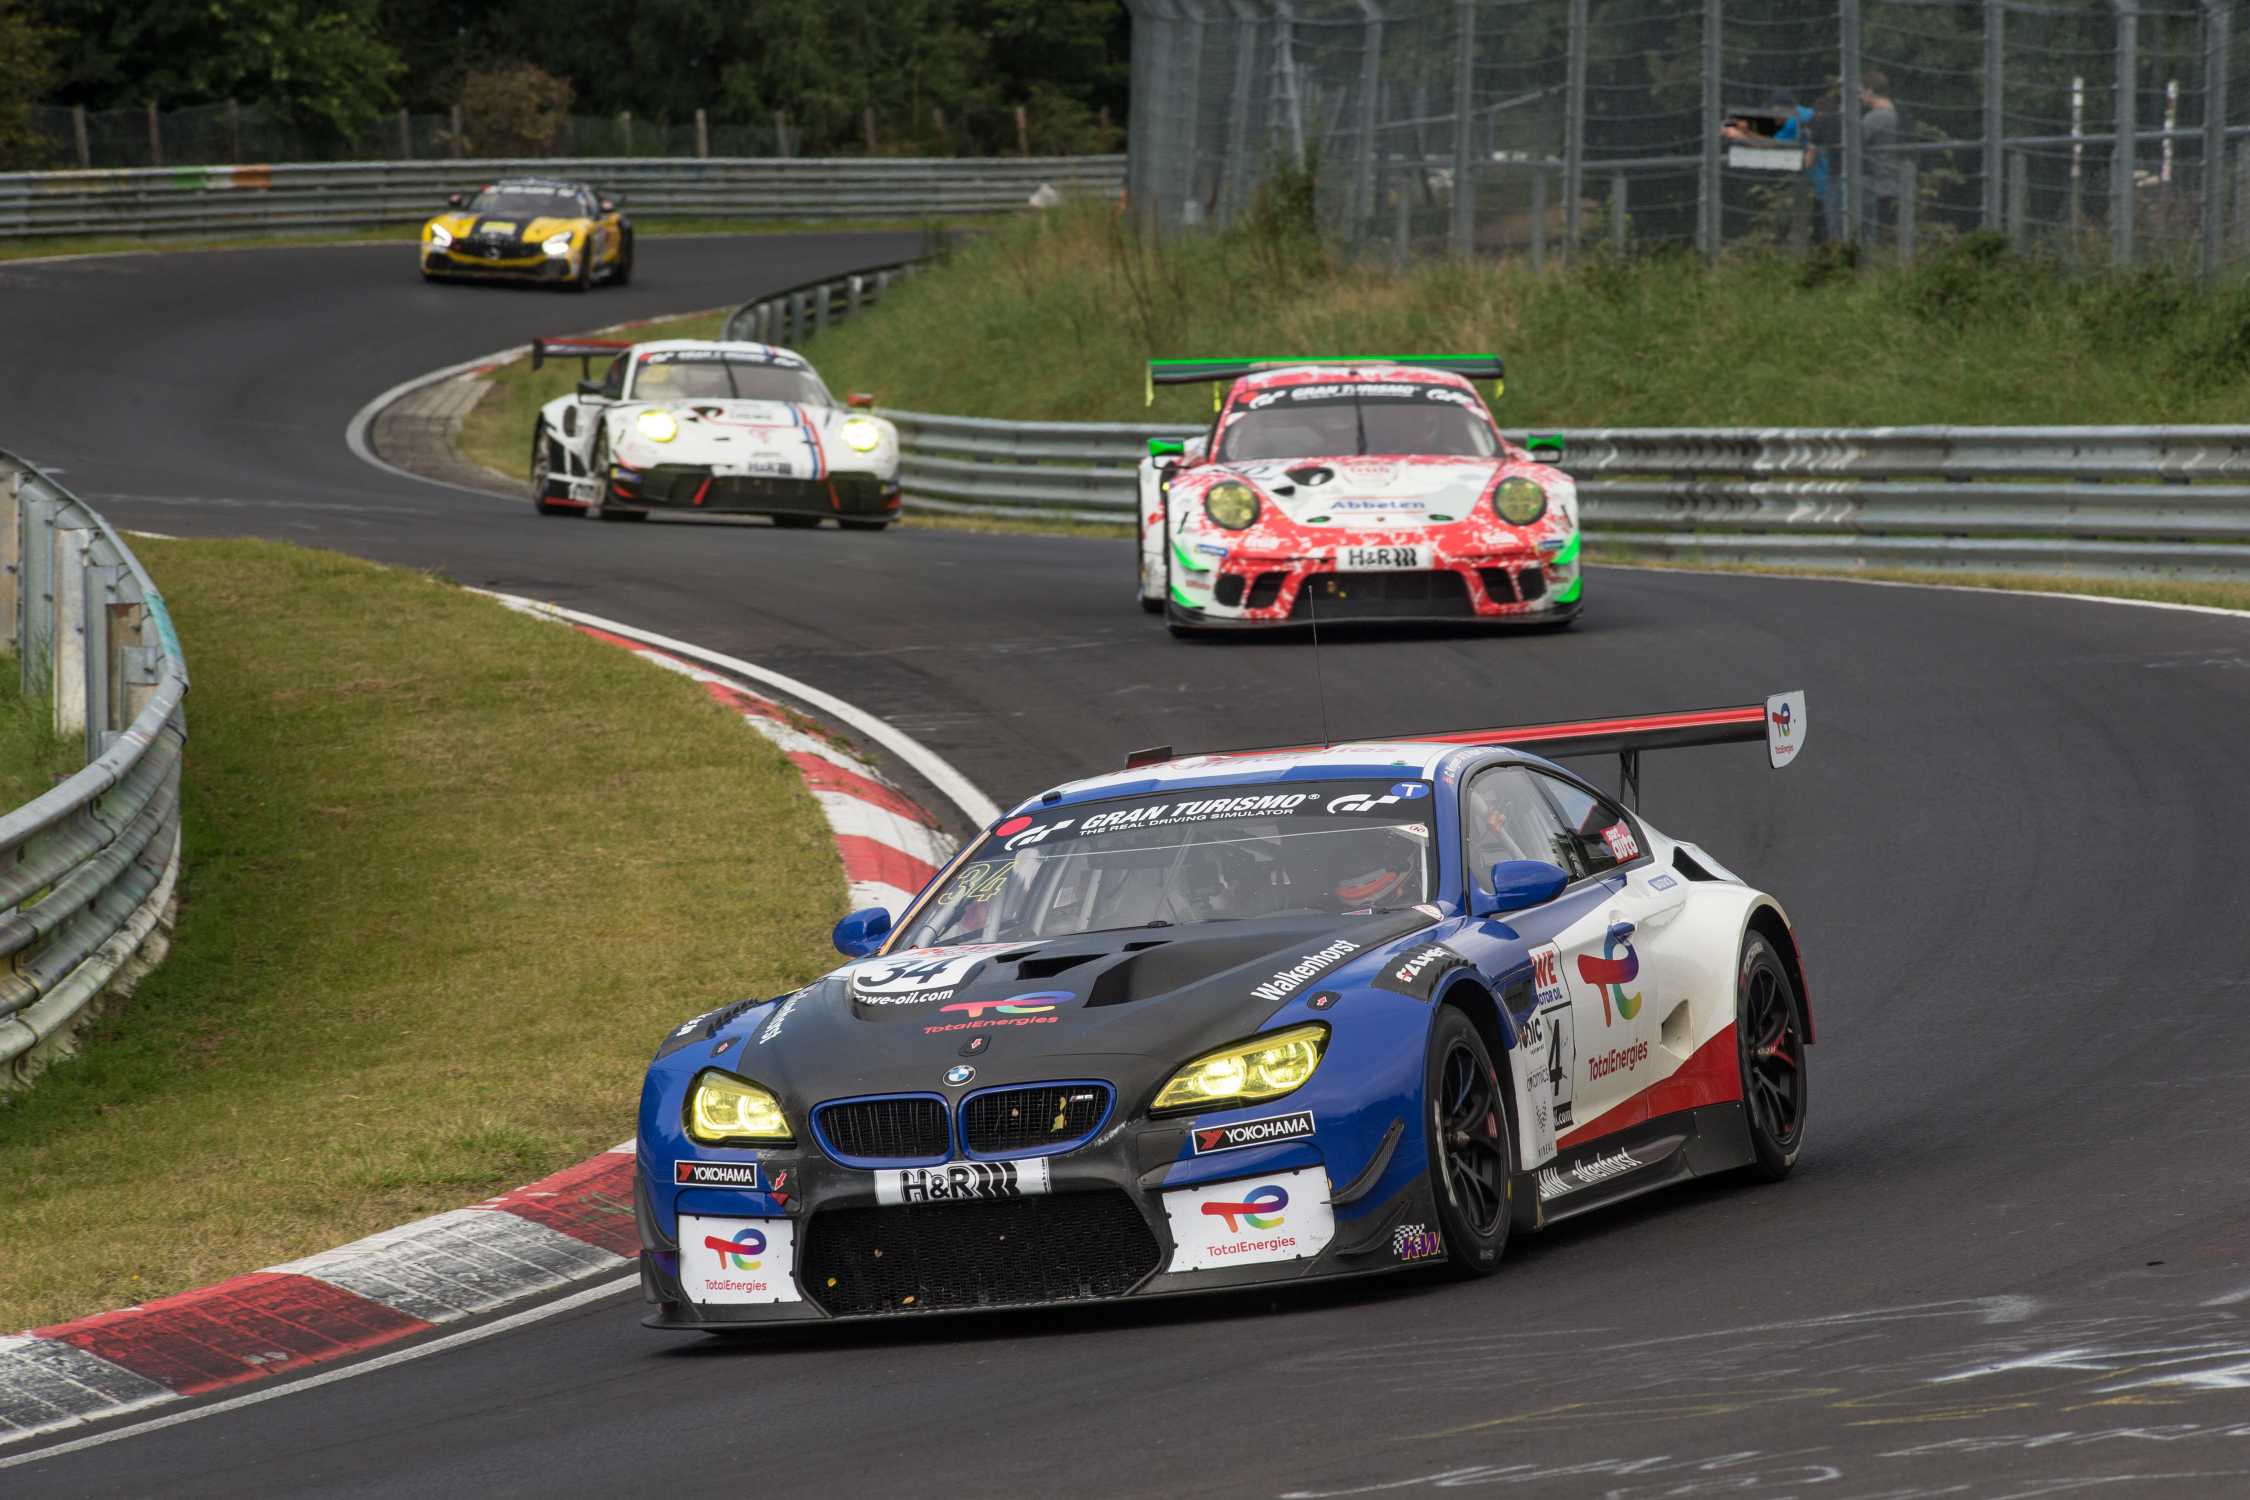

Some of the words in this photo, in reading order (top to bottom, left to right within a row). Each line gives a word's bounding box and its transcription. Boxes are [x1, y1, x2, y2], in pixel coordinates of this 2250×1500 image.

[1080, 827, 1105, 837] THE
[1109, 822, 1146, 832] REAL
[1149, 814, 1206, 827] DRIVING
[1210, 807, 1294, 820] SIMULATOR
[1081, 804, 1168, 830] GRAN
[857, 954, 964, 987] 34
[1250, 939, 1361, 1001] Walkenhorst
[923, 1016, 1059, 1035] TotalEnergies
[1588, 1037, 1648, 1082] TotalEnergies
[1225, 1117, 1310, 1144] YOKOHAMA
[694, 1166, 753, 1183] YOKOHAMA
[901, 1163, 982, 1204] H&R
[1207, 1236, 1296, 1257] TotalEnergies
[704, 1279, 768, 1293] TotalEnergies
